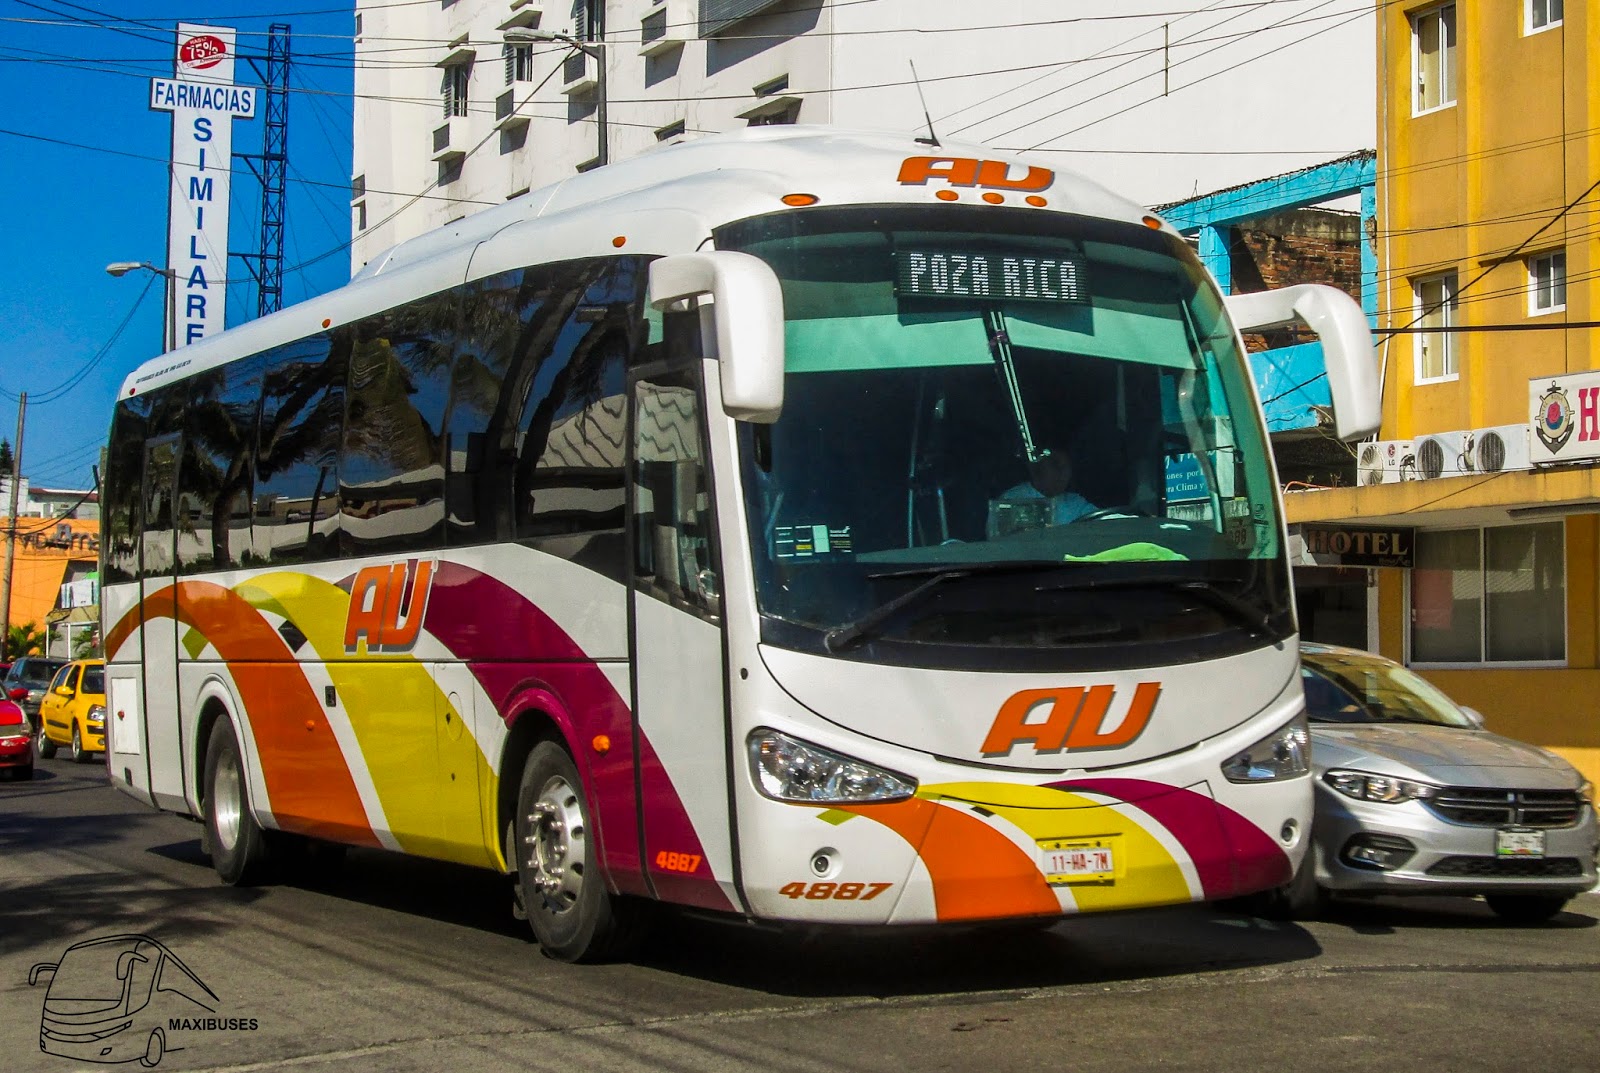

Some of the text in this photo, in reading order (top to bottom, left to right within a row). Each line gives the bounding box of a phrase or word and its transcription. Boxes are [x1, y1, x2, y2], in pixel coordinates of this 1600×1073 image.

[186, 40, 219, 60] 75%
[155, 82, 251, 113] FARMACIAS
[897, 156, 1055, 192] AU
[910, 253, 1078, 299] POZA RICA
[1578, 387, 1600, 441] H
[1175, 482, 1198, 492] Clima
[1187, 470, 1199, 480] por
[1307, 531, 1409, 555] HOTEL
[344, 560, 434, 653] AU
[980, 682, 1162, 758] AU
[656, 850, 701, 873] 4887
[779, 882, 893, 900] 4887
